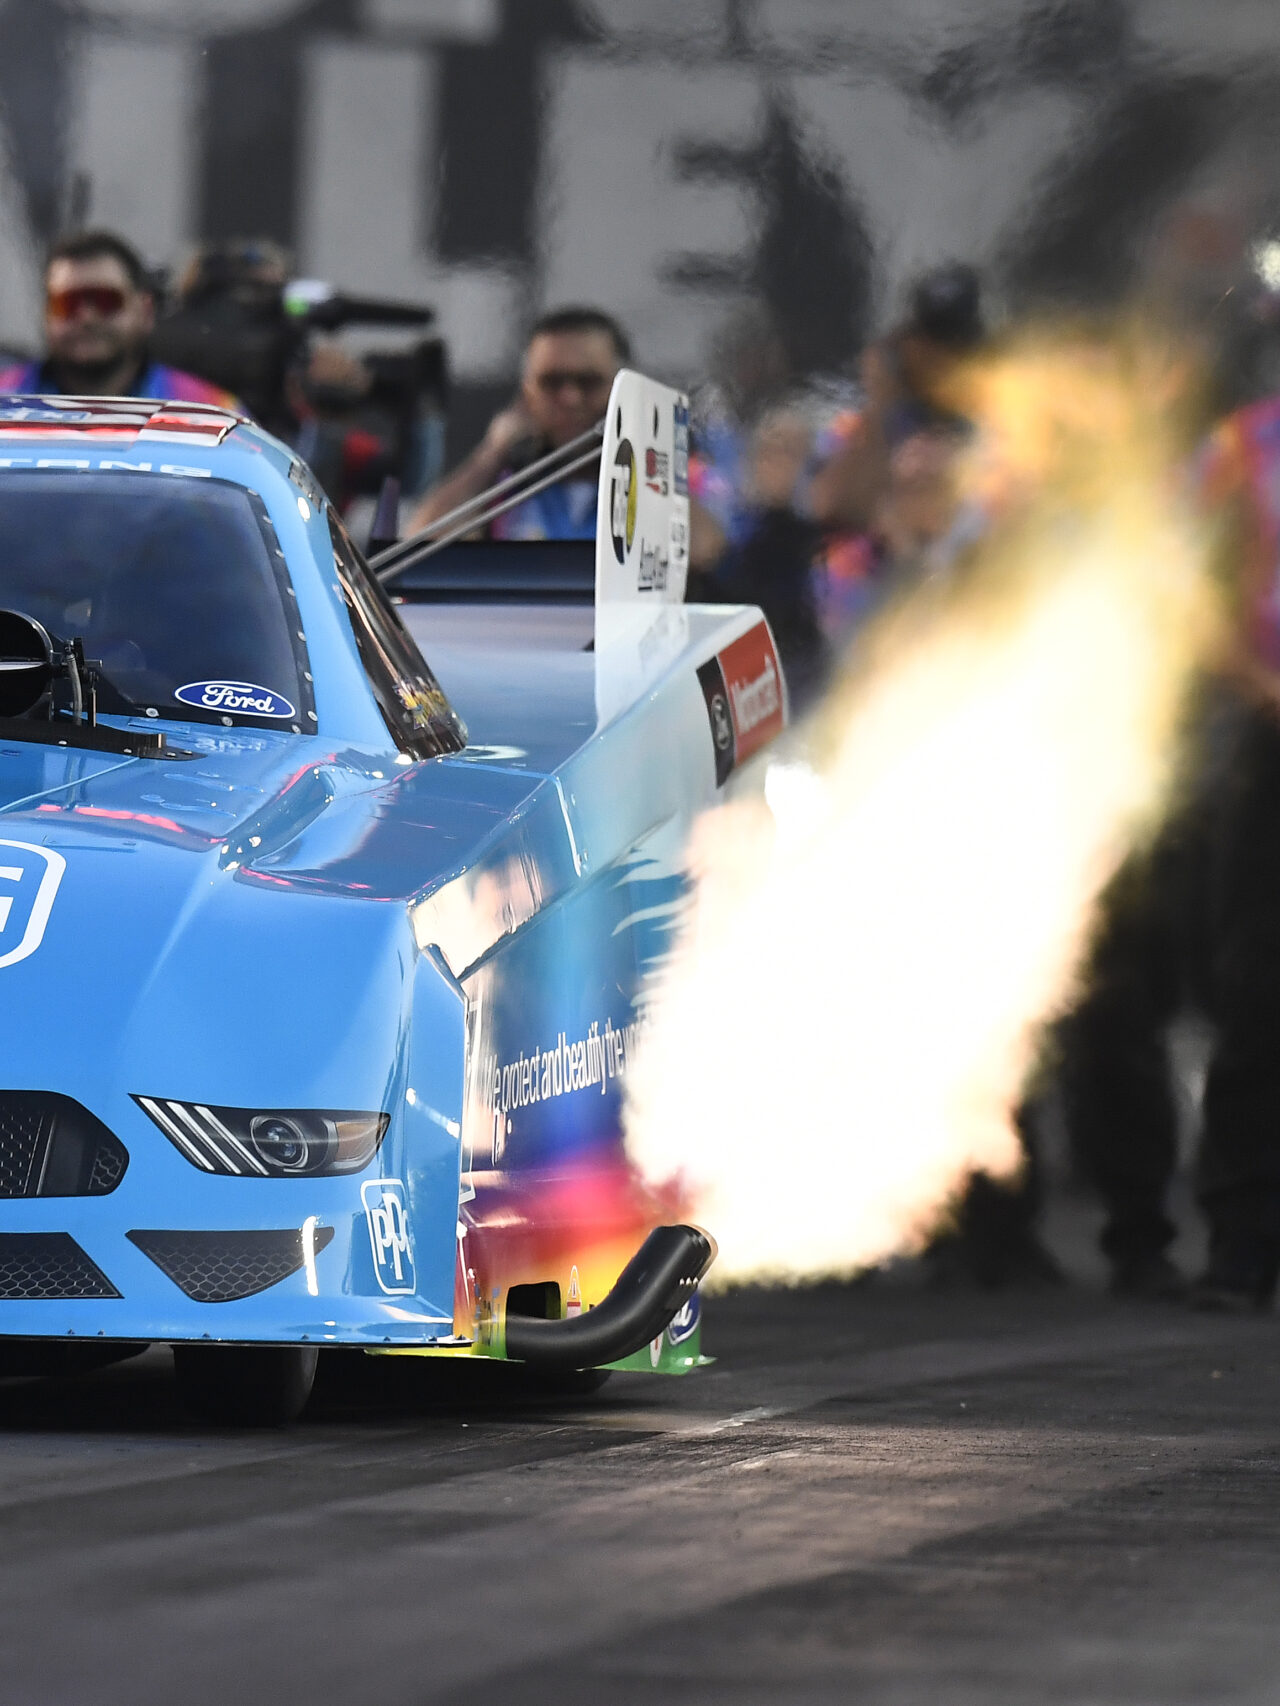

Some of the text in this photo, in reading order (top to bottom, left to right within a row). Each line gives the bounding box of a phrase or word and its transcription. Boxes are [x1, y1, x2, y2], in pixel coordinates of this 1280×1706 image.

[201, 684, 275, 713] Ford
[501, 1045, 541, 1124] protect
[541, 1032, 562, 1100] and
[562, 1021, 605, 1095] beautify
